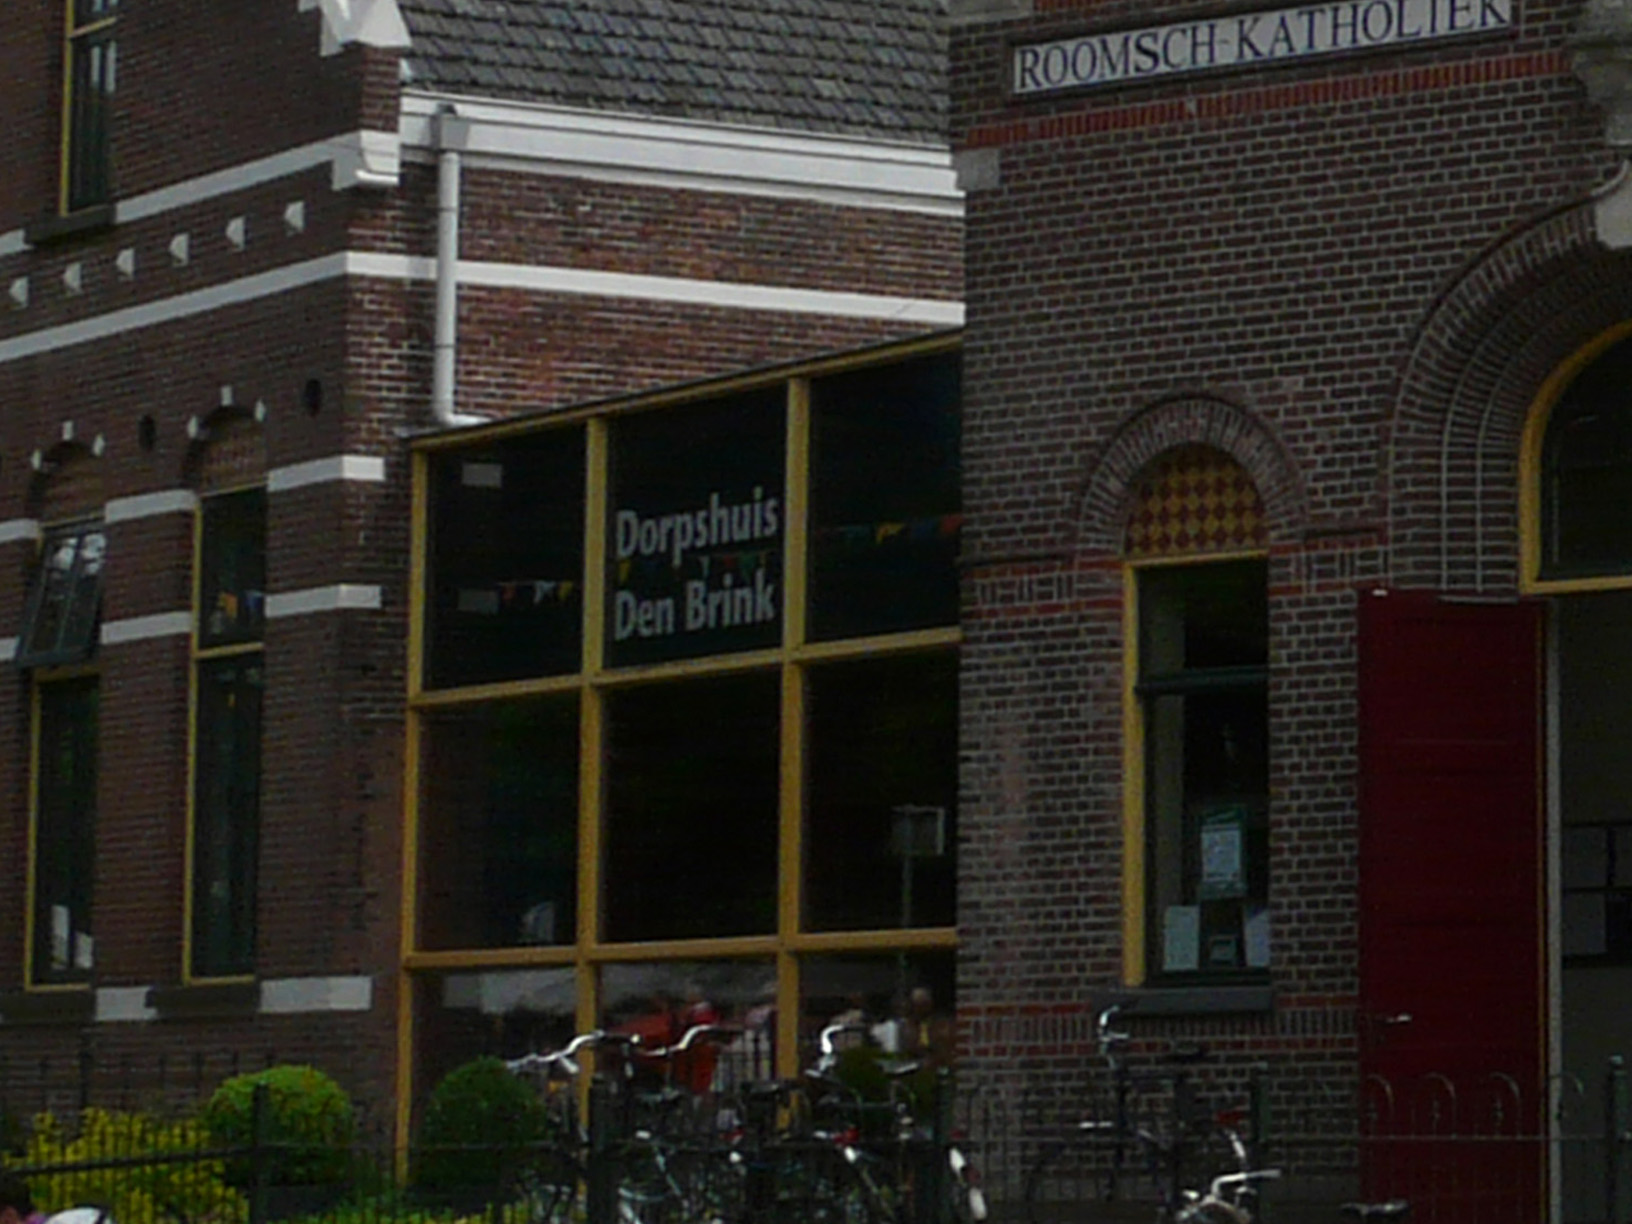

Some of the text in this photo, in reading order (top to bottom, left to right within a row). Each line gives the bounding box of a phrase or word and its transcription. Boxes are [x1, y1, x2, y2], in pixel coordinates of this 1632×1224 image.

[616, 485, 779, 568] Dorpshuis
[615, 567, 774, 642] Den Brink
